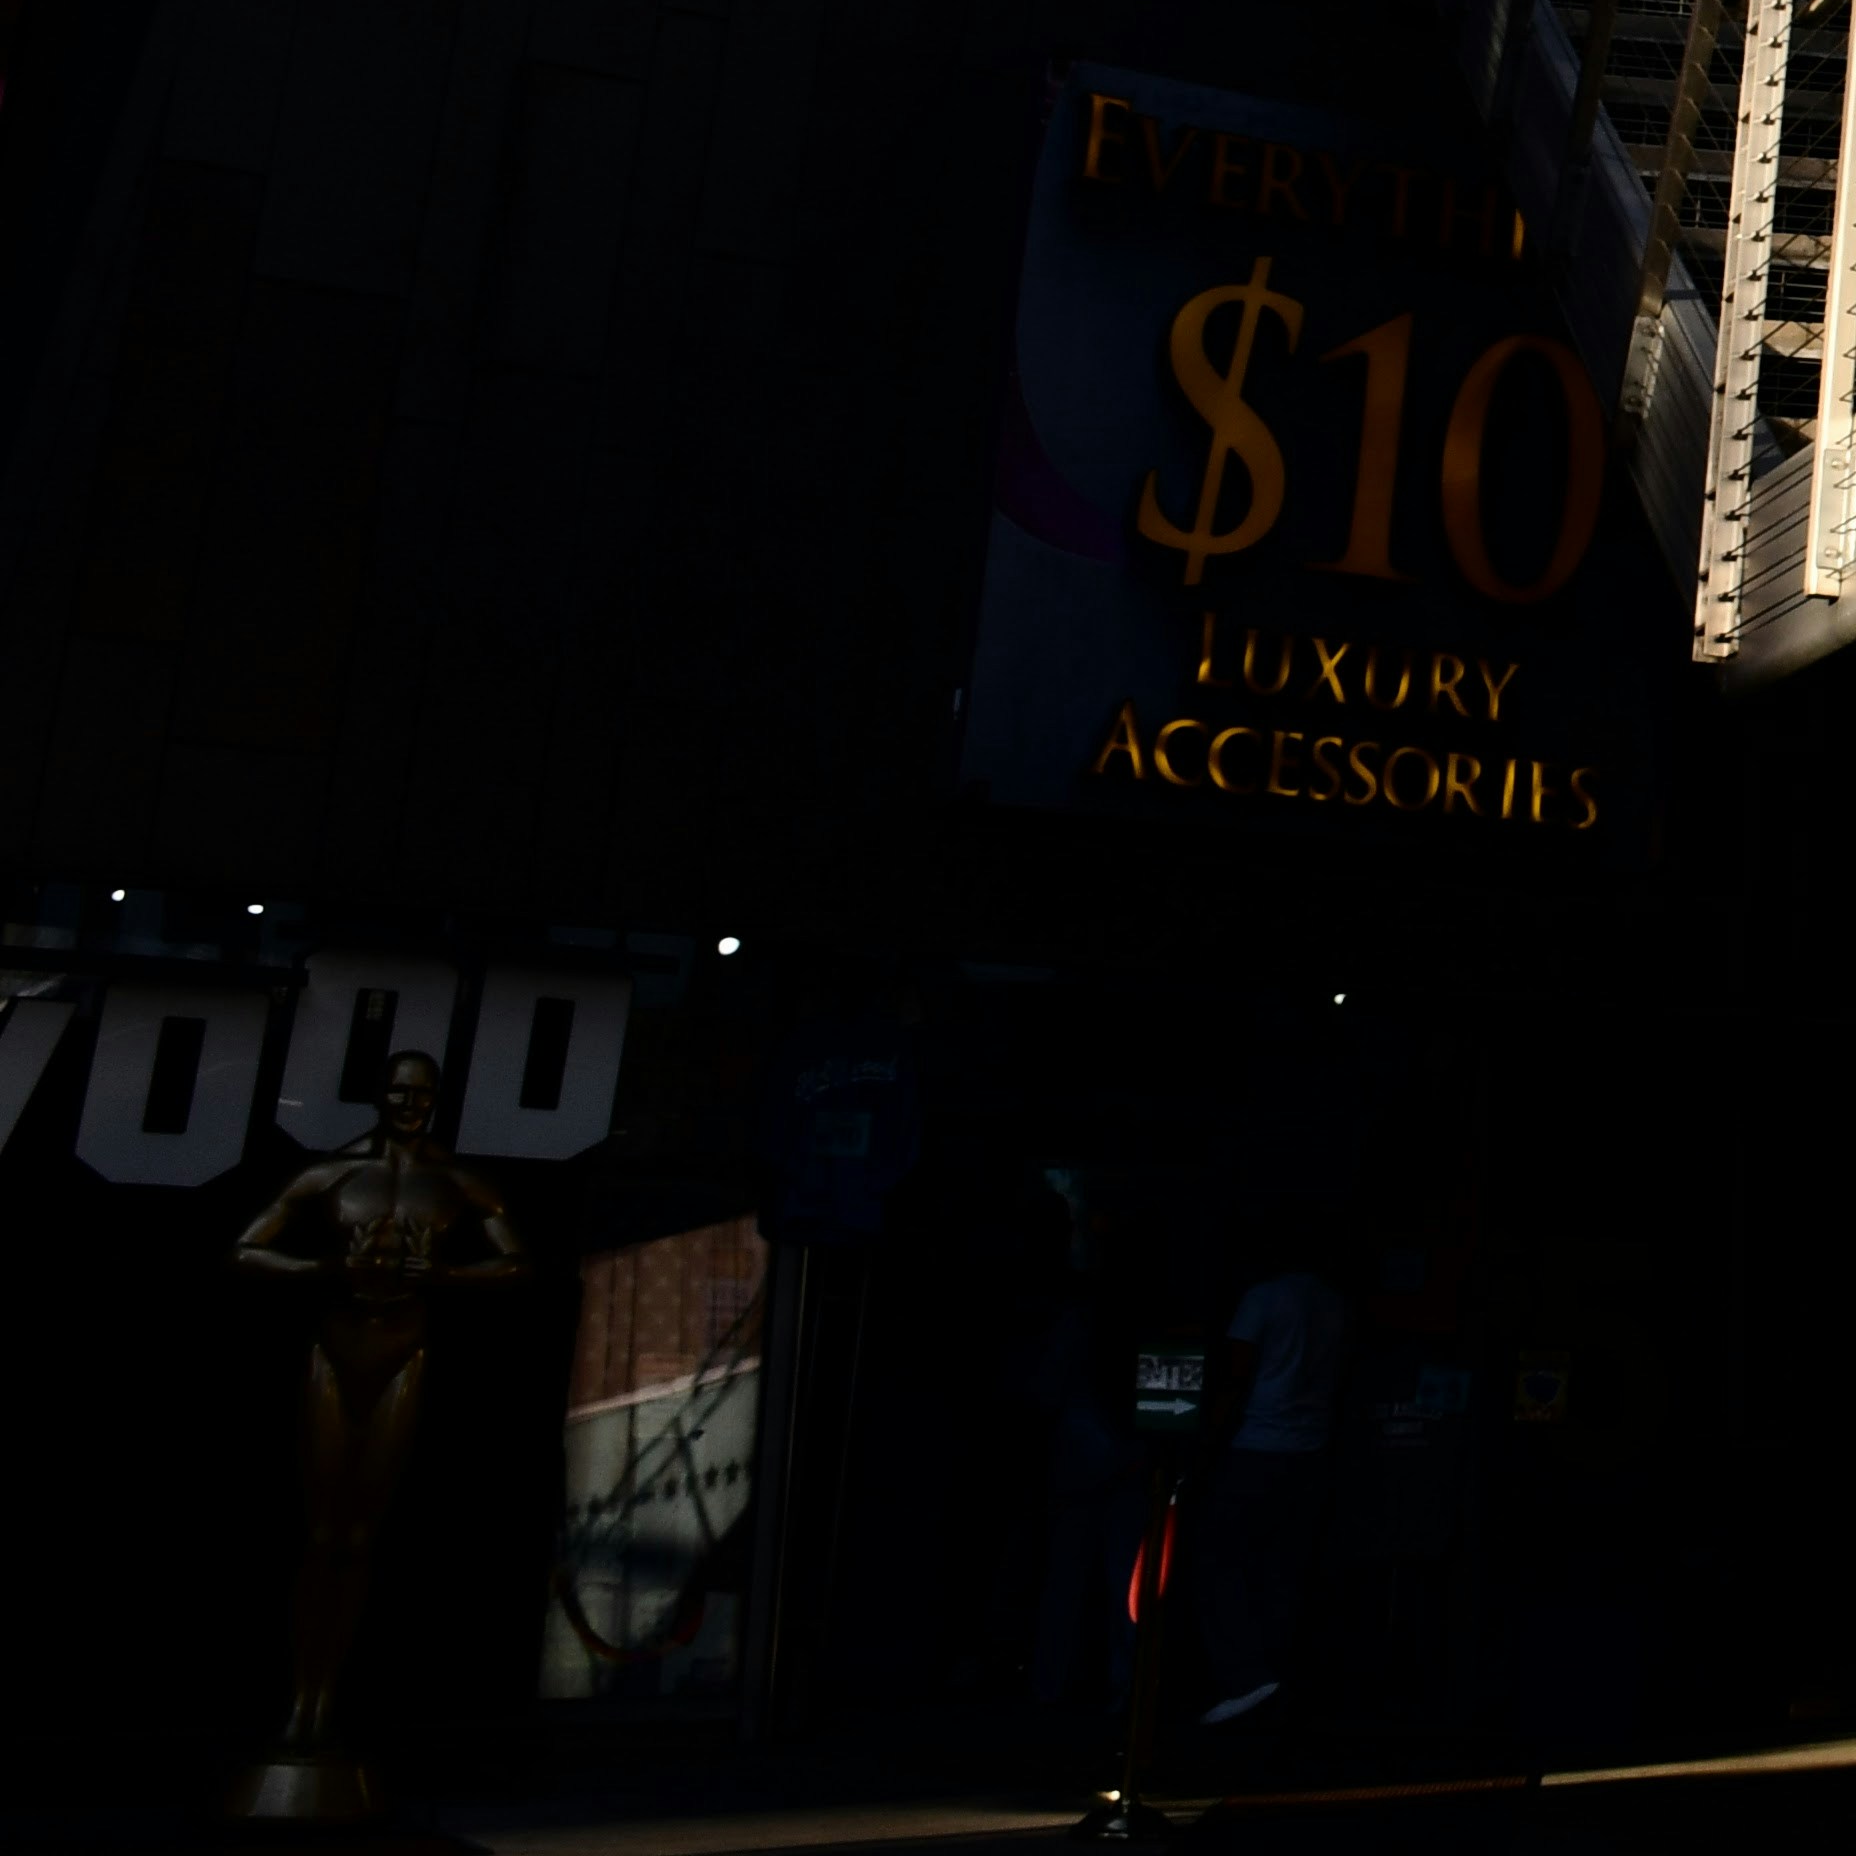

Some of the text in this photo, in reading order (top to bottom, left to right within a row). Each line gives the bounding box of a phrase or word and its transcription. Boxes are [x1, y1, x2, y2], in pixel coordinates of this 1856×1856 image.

[1135, 255, 1608, 608] $10
[1197, 608, 1520, 722] LUXURY
[1088, 697, 1600, 832] ACCESSORIES
